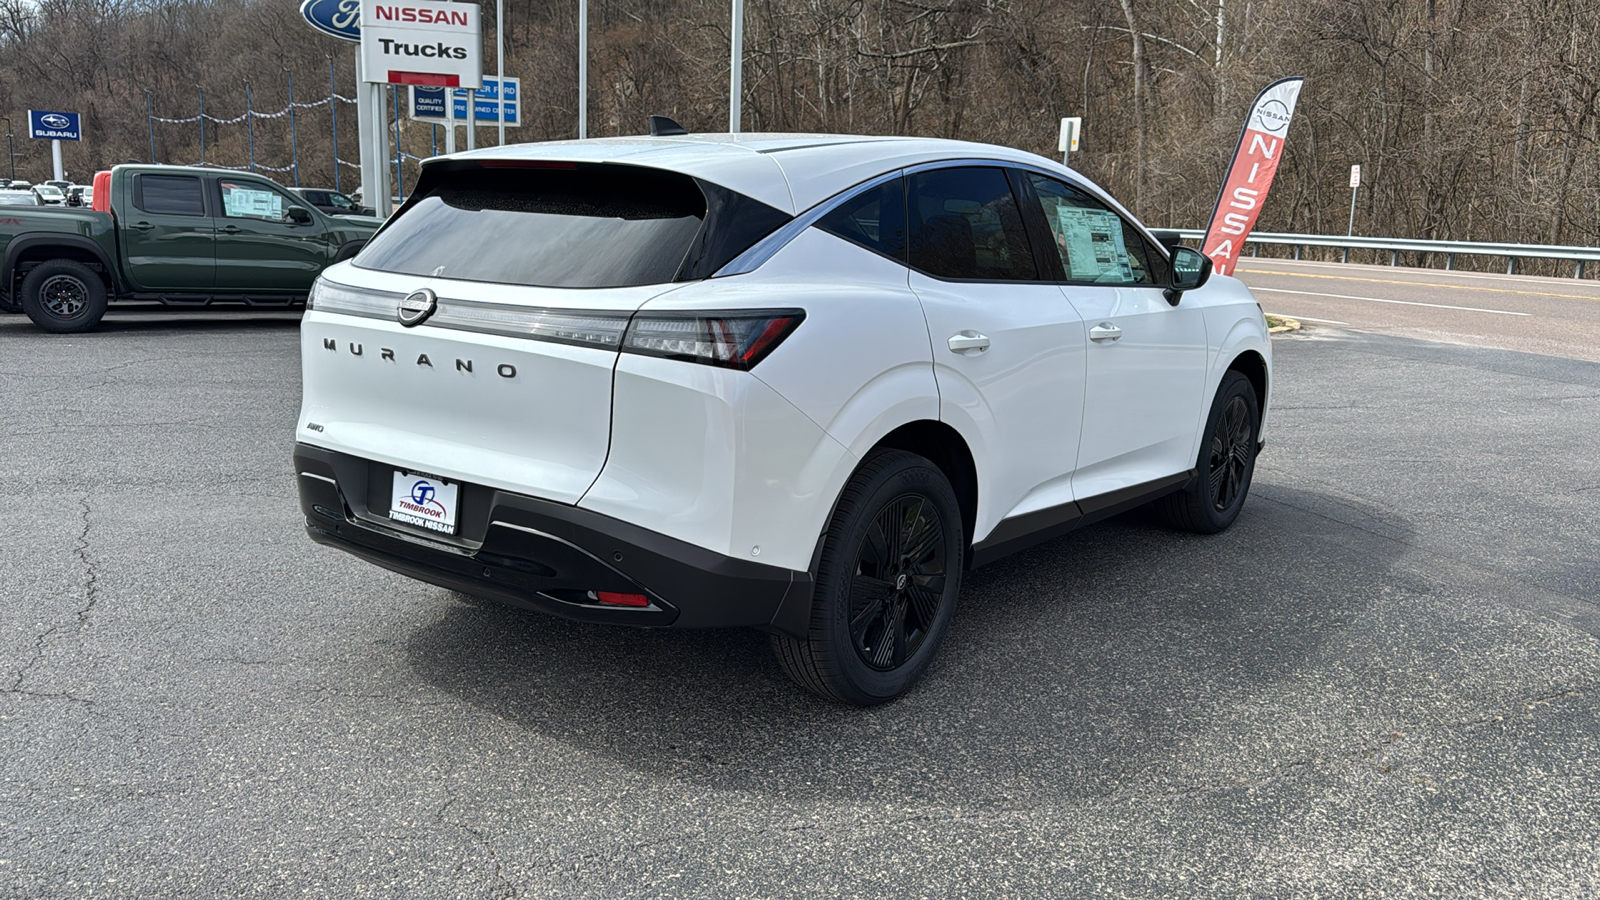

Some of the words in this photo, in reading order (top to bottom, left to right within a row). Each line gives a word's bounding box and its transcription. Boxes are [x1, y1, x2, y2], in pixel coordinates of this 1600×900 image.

[375, 5, 468, 26] NISSAN
[378, 38, 468, 60] Trucks
[493, 85, 516, 95] FRD
[416, 104, 445, 112] CERTIFIED
[417, 97, 443, 105] QUALITY
[1256, 107, 1291, 123] NISSAN
[35, 129, 77, 138] SUBARU
[323, 337, 518, 379] MURANO
[306, 422, 325, 433] AWD
[399, 500, 443, 518] TIMBROOK
[389, 510, 425, 527] TIMBROOK
[424, 519, 455, 535] NISSAN
